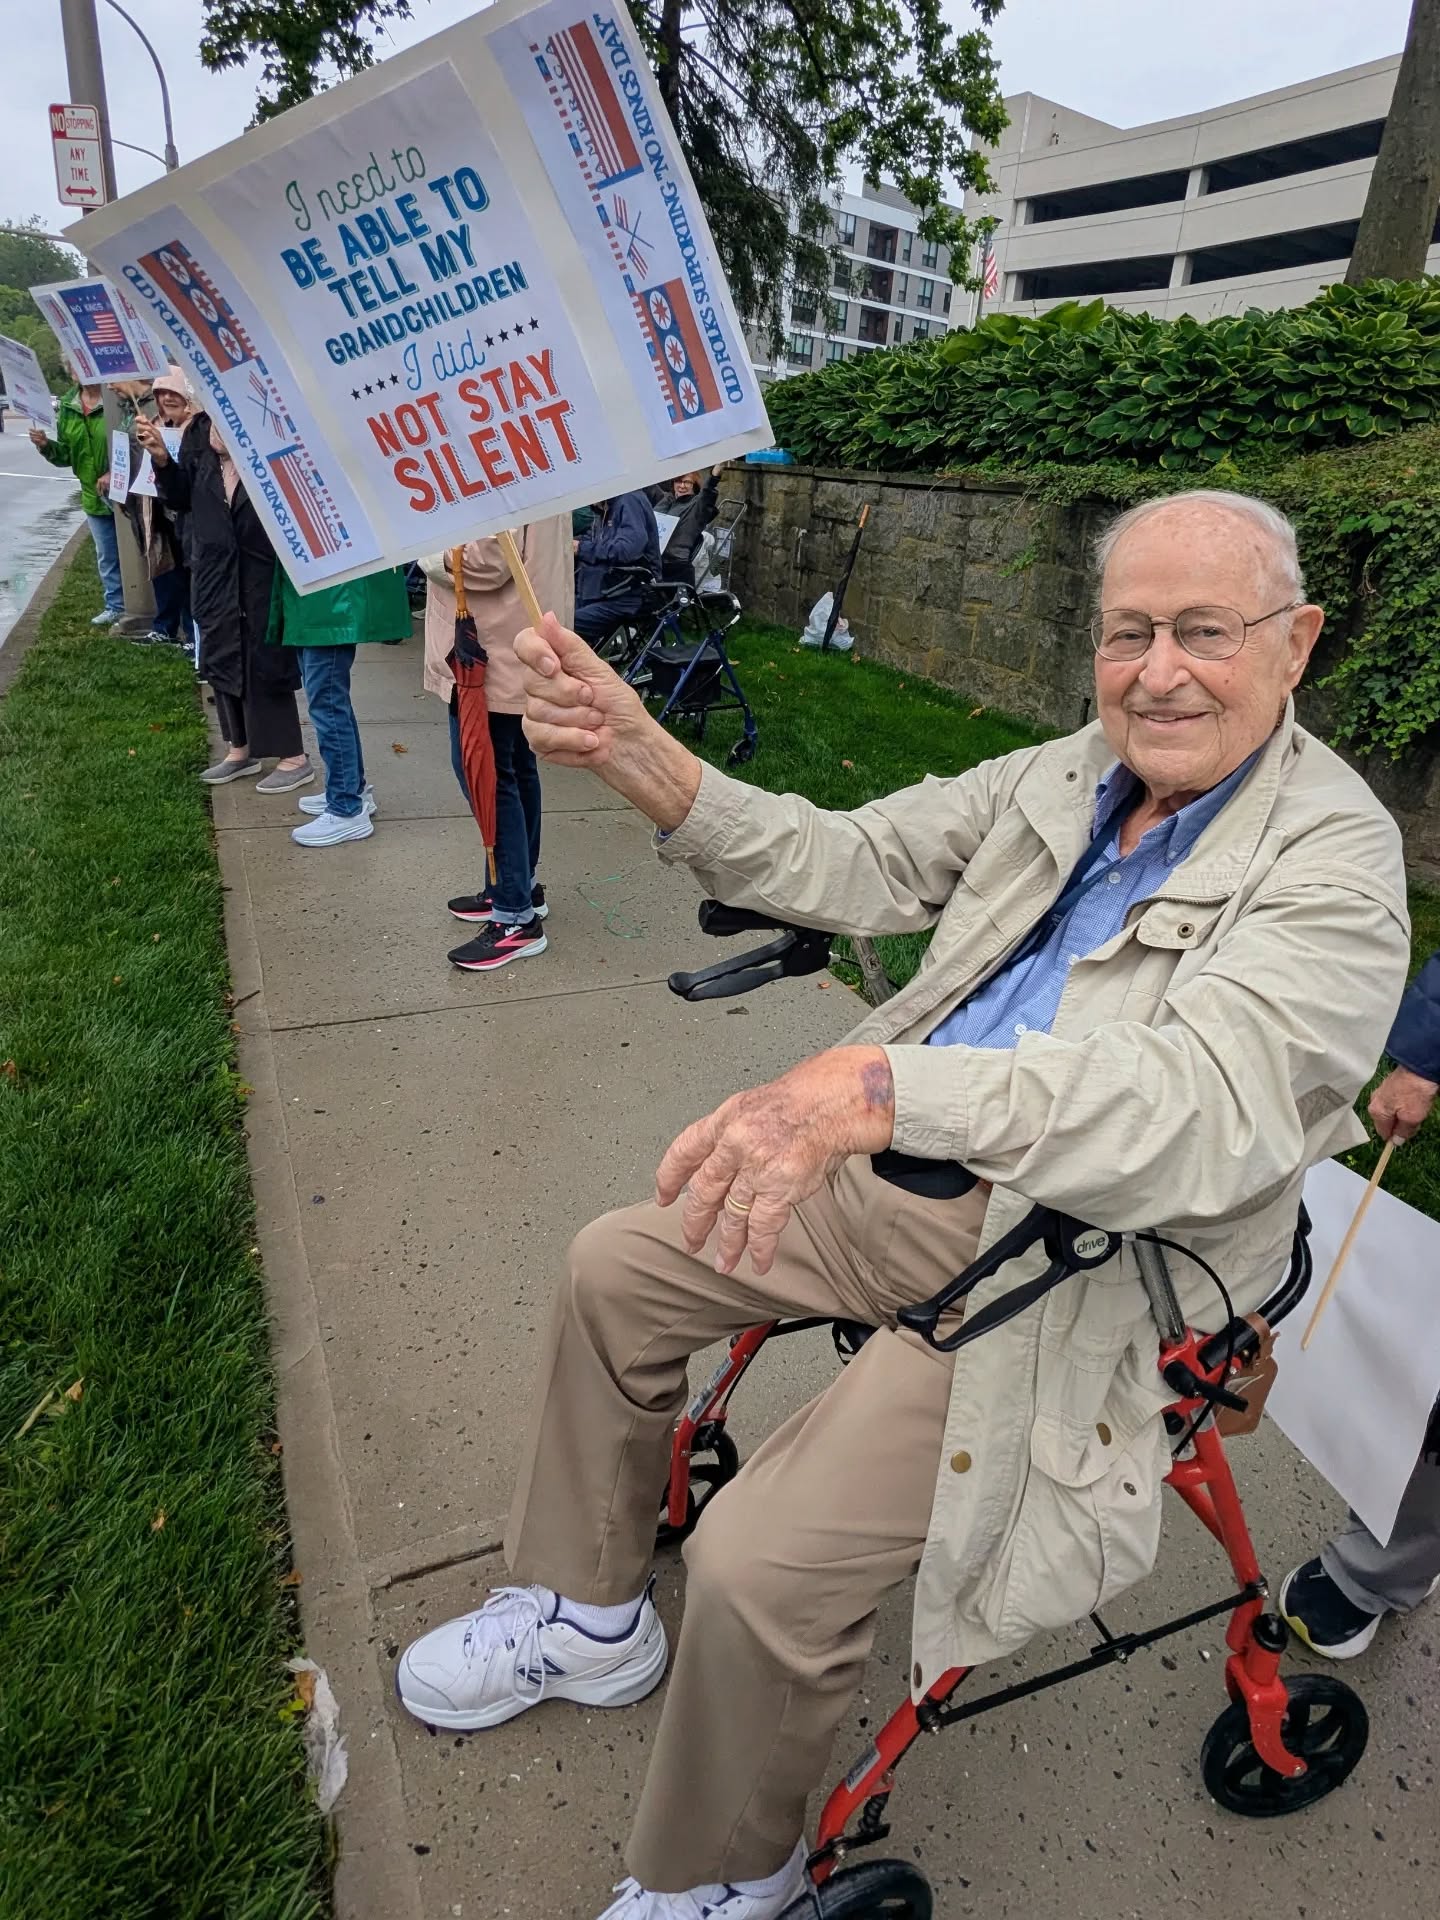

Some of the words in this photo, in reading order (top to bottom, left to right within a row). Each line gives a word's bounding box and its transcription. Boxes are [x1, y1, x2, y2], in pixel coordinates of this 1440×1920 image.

[51, 112, 66, 132] NO
[66, 118, 94, 130] STOPPING
[619, 69, 656, 140] KINGS
[70, 147, 86, 160] ANY
[71, 167, 89, 181] TIME
[286, 180, 311, 231] I
[317, 152, 396, 220] need
[391, 146, 426, 183] to
[280, 237, 335, 290] BE
[338, 193, 430, 267] ABLE
[428, 166, 490, 221] TO
[660, 181, 710, 305] SUPPORTING
[328, 257, 419, 320] TELL
[419, 223, 477, 283] MY
[325, 261, 529, 366] GRANDCHILDREN
[700, 306, 732, 366] FOLKS
[94, 345, 130, 356] AMERICA
[403, 342, 422, 391] I
[432, 329, 486, 379] did
[721, 366, 744, 404] OLD
[122, 264, 156, 299] OLD
[152, 297, 195, 350] FOLKS
[189, 350, 253, 449] SUPPORTING
[260, 480, 291, 526] KINGS
[366, 391, 451, 457] NOT
[458, 348, 560, 423] STAY
[393, 400, 582, 514] SILENT
[1076, 1236, 1106, 1254] drive
